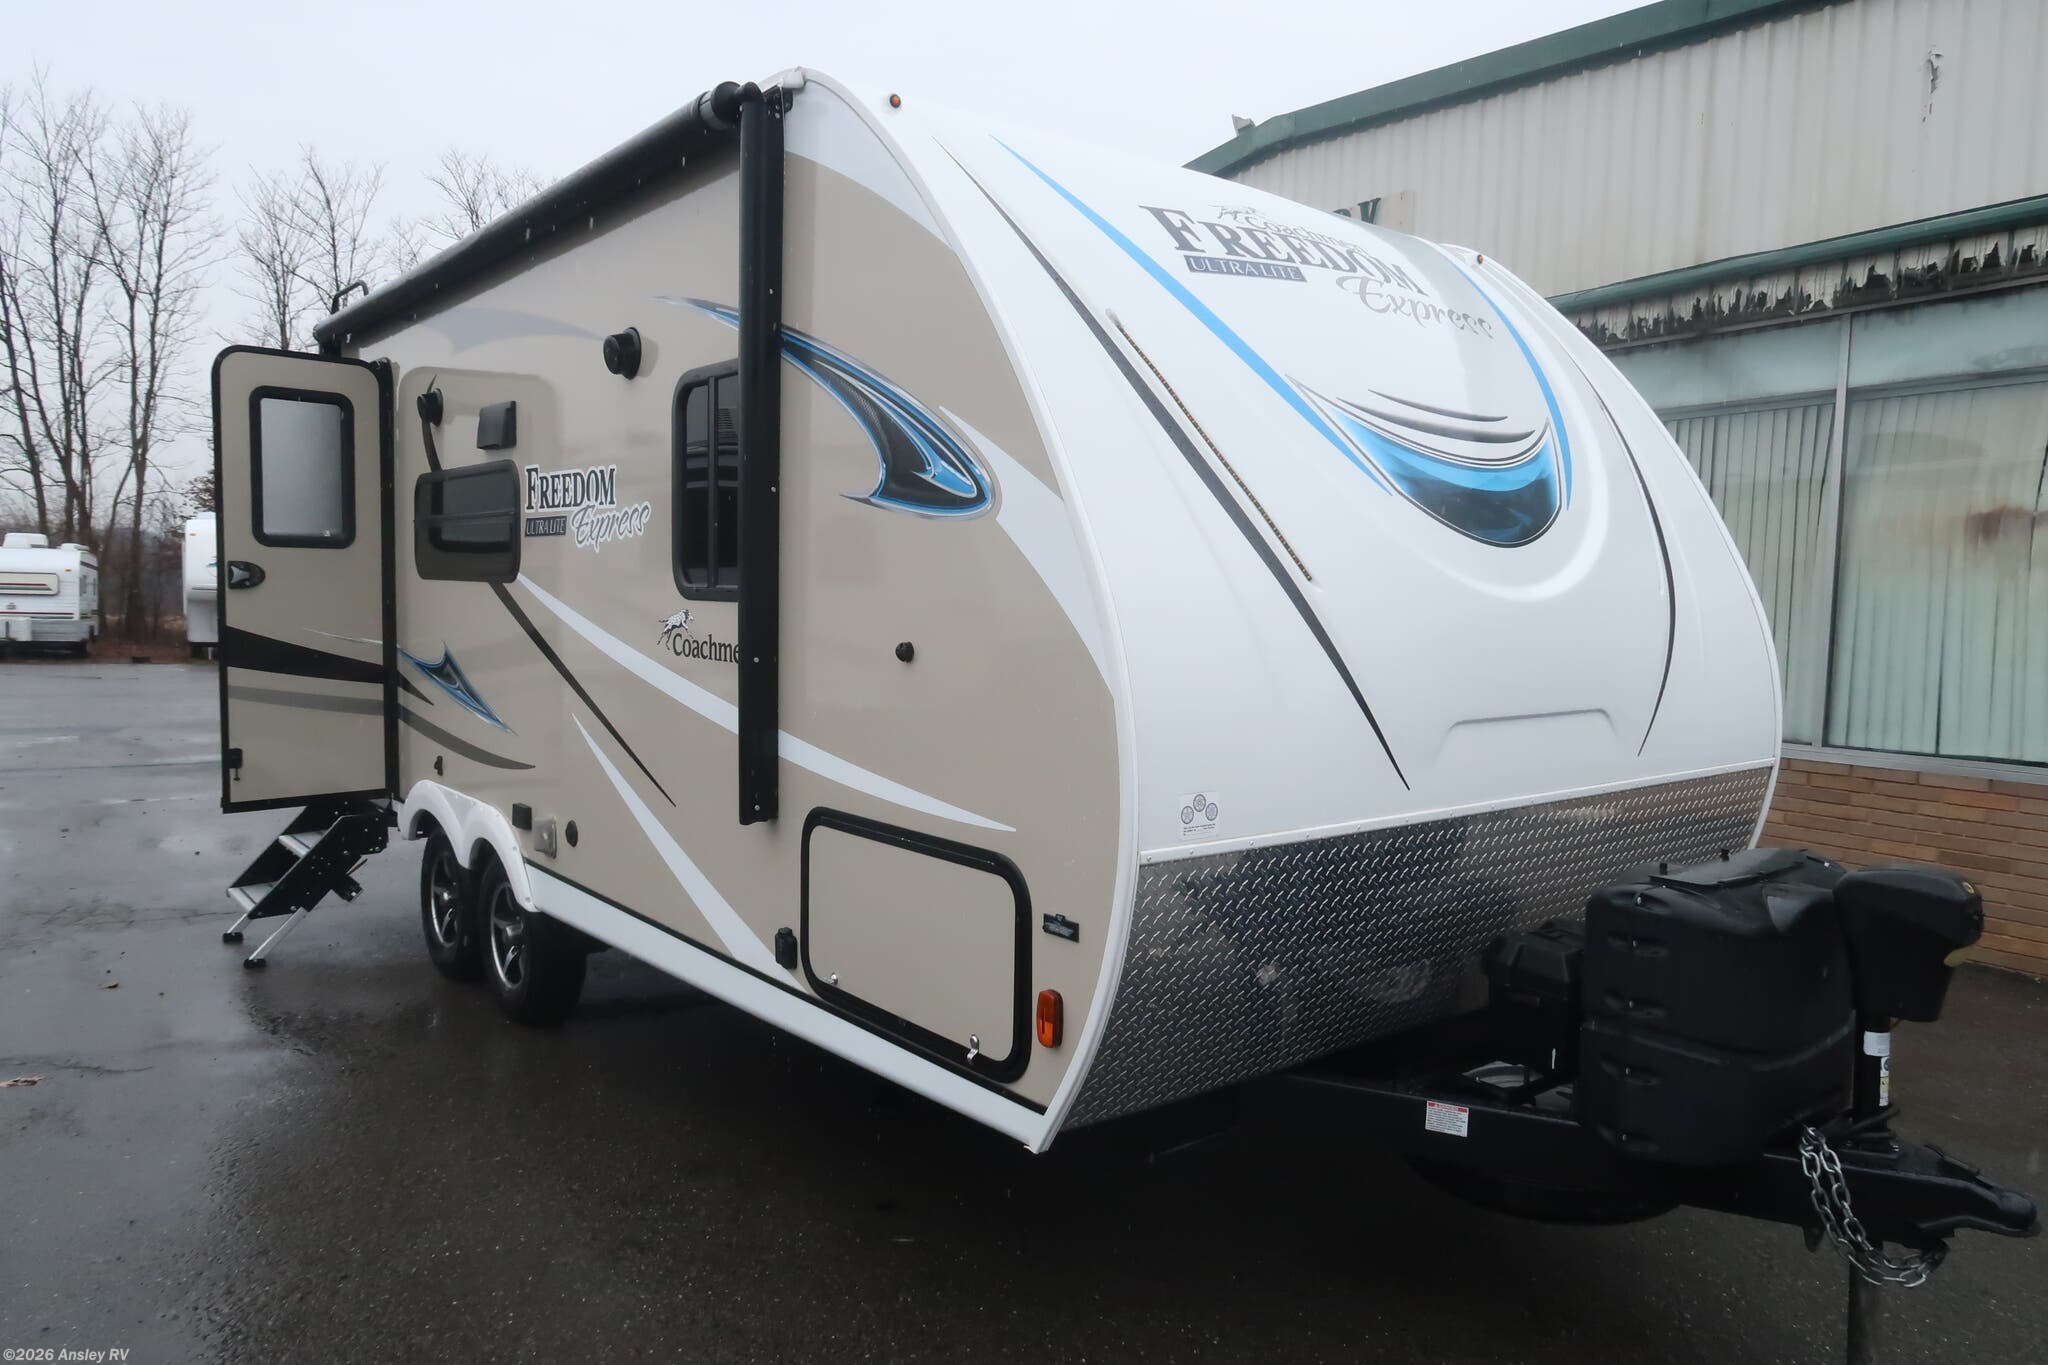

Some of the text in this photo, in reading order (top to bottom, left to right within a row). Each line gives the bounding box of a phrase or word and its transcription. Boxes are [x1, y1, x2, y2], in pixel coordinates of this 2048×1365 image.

[1138, 205, 1429, 297] FREEDOM
[1335, 275, 1494, 340] Express
[525, 466, 616, 511] FREEDOM
[571, 504, 650, 549] Express
[672, 632, 740, 665] Coachme
